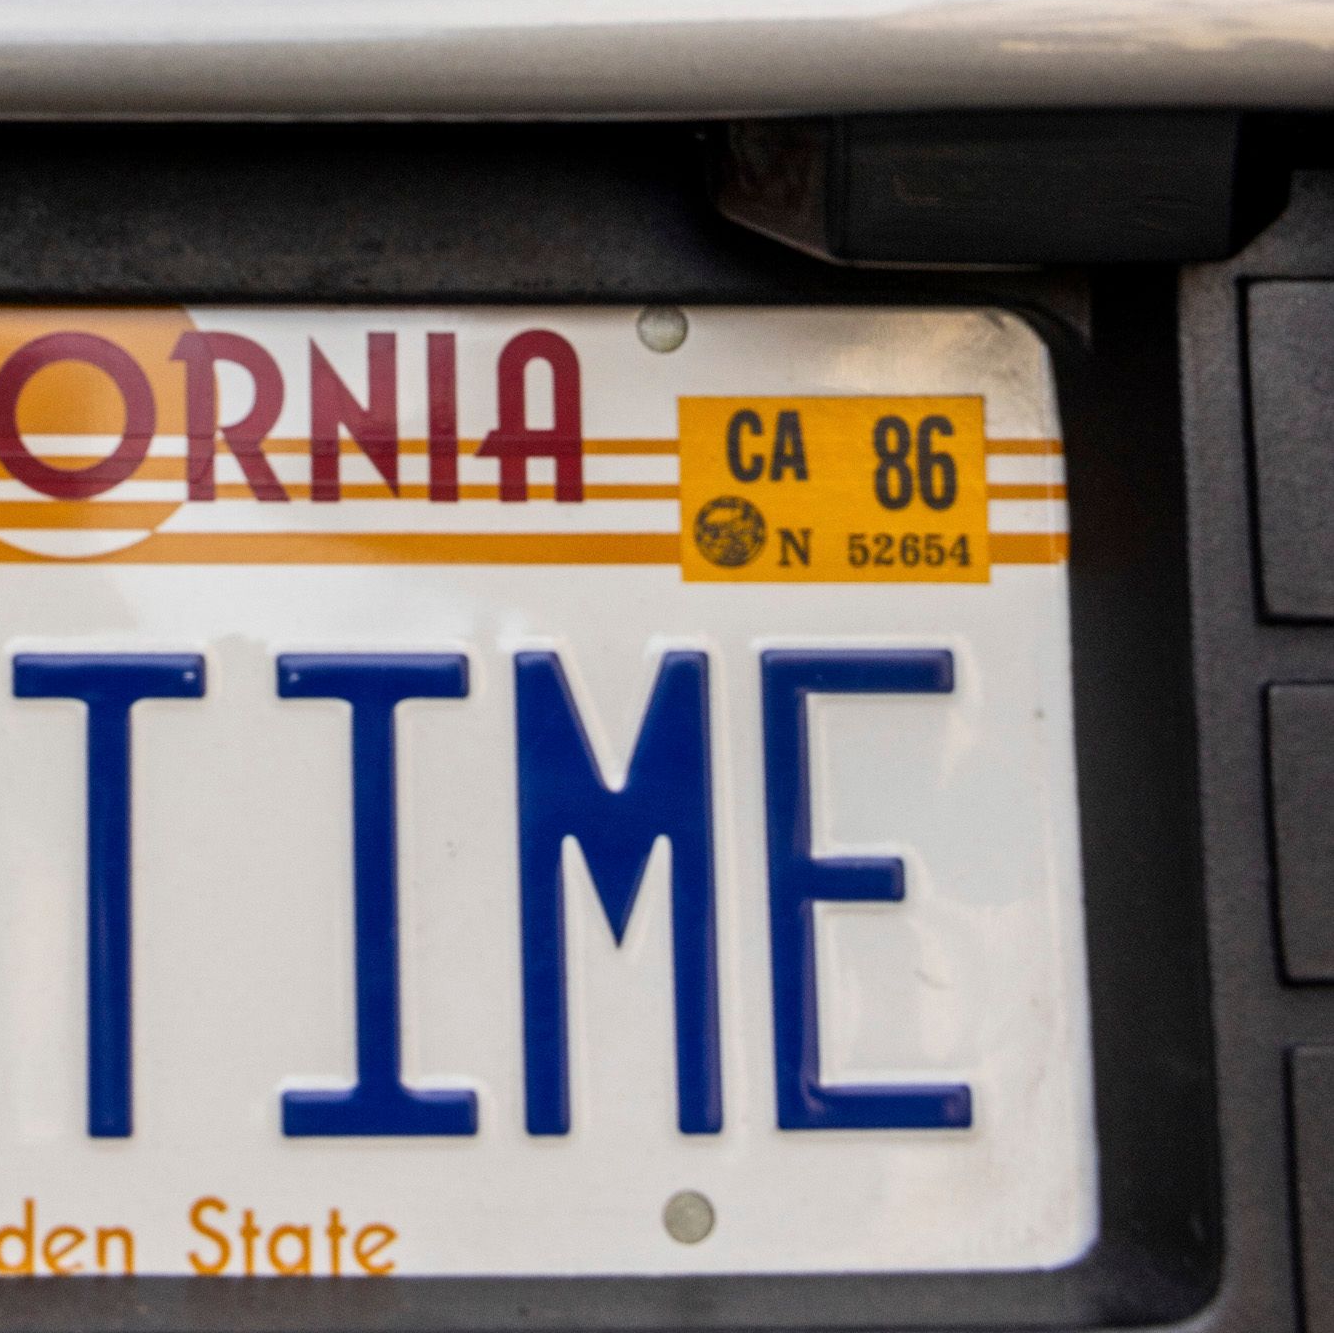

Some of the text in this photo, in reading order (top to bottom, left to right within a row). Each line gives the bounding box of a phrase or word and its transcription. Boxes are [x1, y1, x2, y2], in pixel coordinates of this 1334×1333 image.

[726, 408, 958, 511] CA 86
[778, 528, 972, 568] N 52654
[187, 1196, 398, 1276] State
